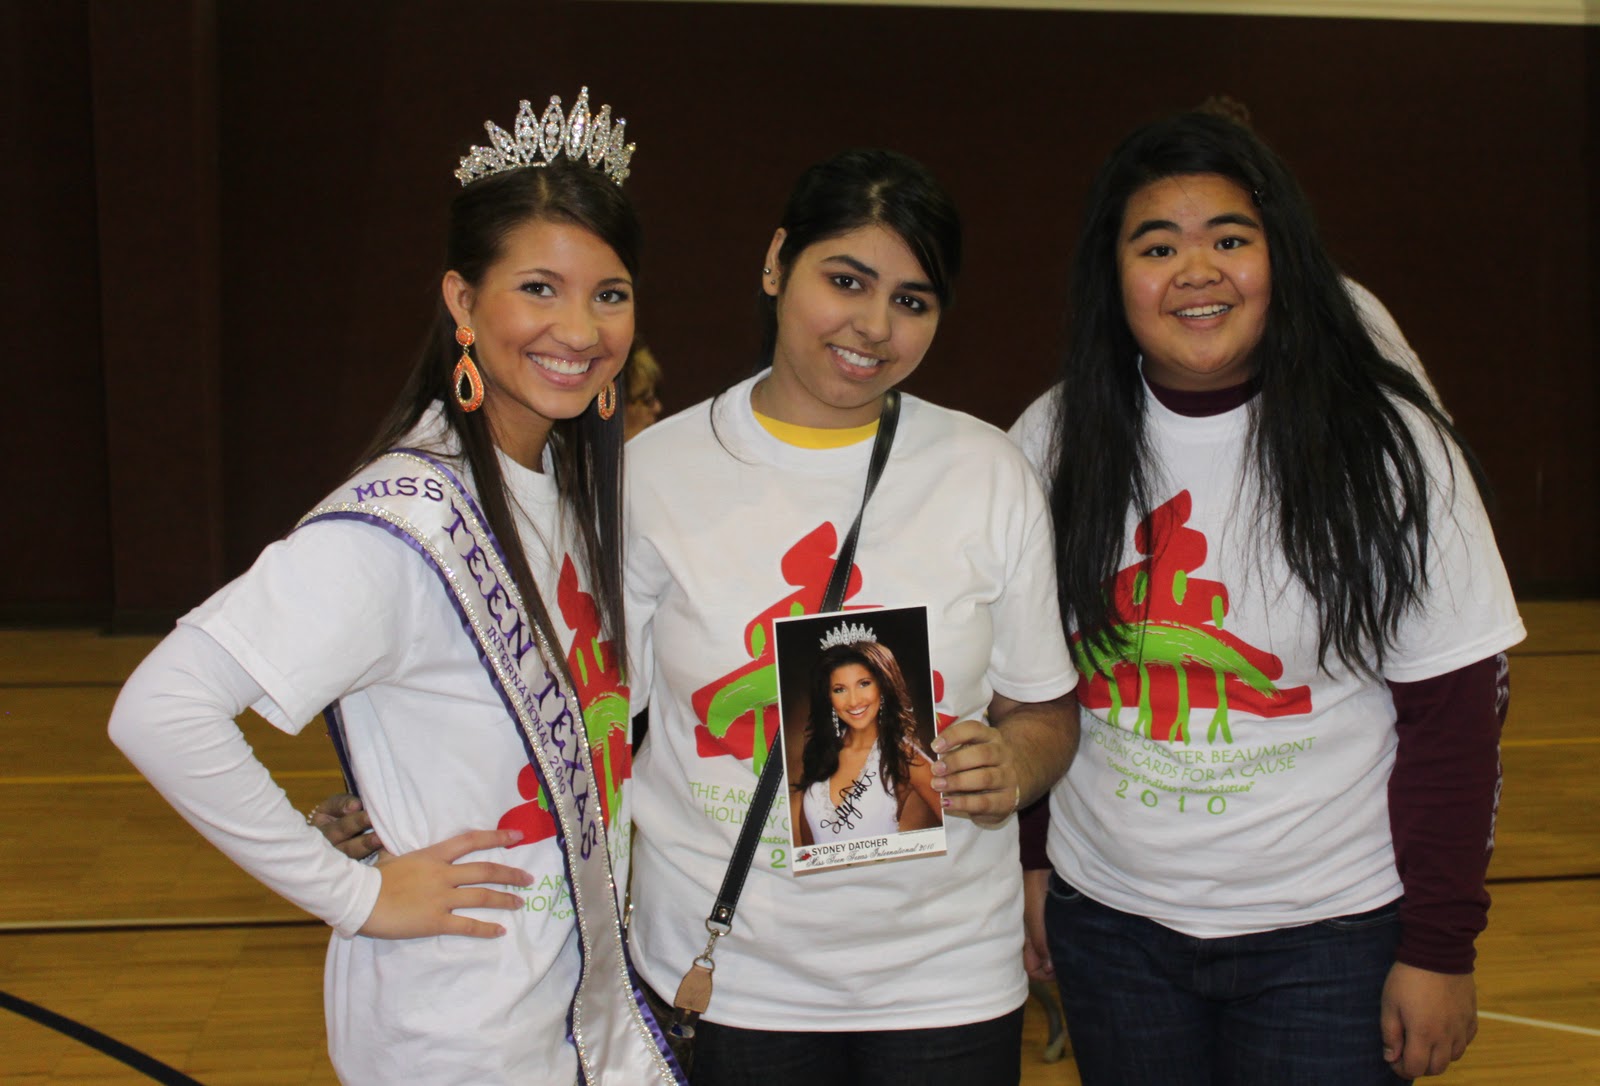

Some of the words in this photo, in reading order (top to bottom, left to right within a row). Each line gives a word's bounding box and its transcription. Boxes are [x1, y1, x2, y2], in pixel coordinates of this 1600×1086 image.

[352, 476, 444, 503] MISS
[441, 497, 538, 671] TEEN
[534, 669, 598, 861] TEXAS
[486, 624, 551, 752] INTERNATIONAL
[549, 755, 567, 795] 2010
[1211, 736, 1317, 763] BEAUMONT
[1131, 751, 1180, 779] CARDS
[1181, 767, 1216, 782] FOR
[1220, 767, 1236, 781] A
[1240, 755, 1297, 778] CAUSE
[688, 781, 720, 801] THE
[811, 842, 847, 857] SYDNEY
[848, 837, 889, 851] DATCHER
[870, 843, 919, 858] International
